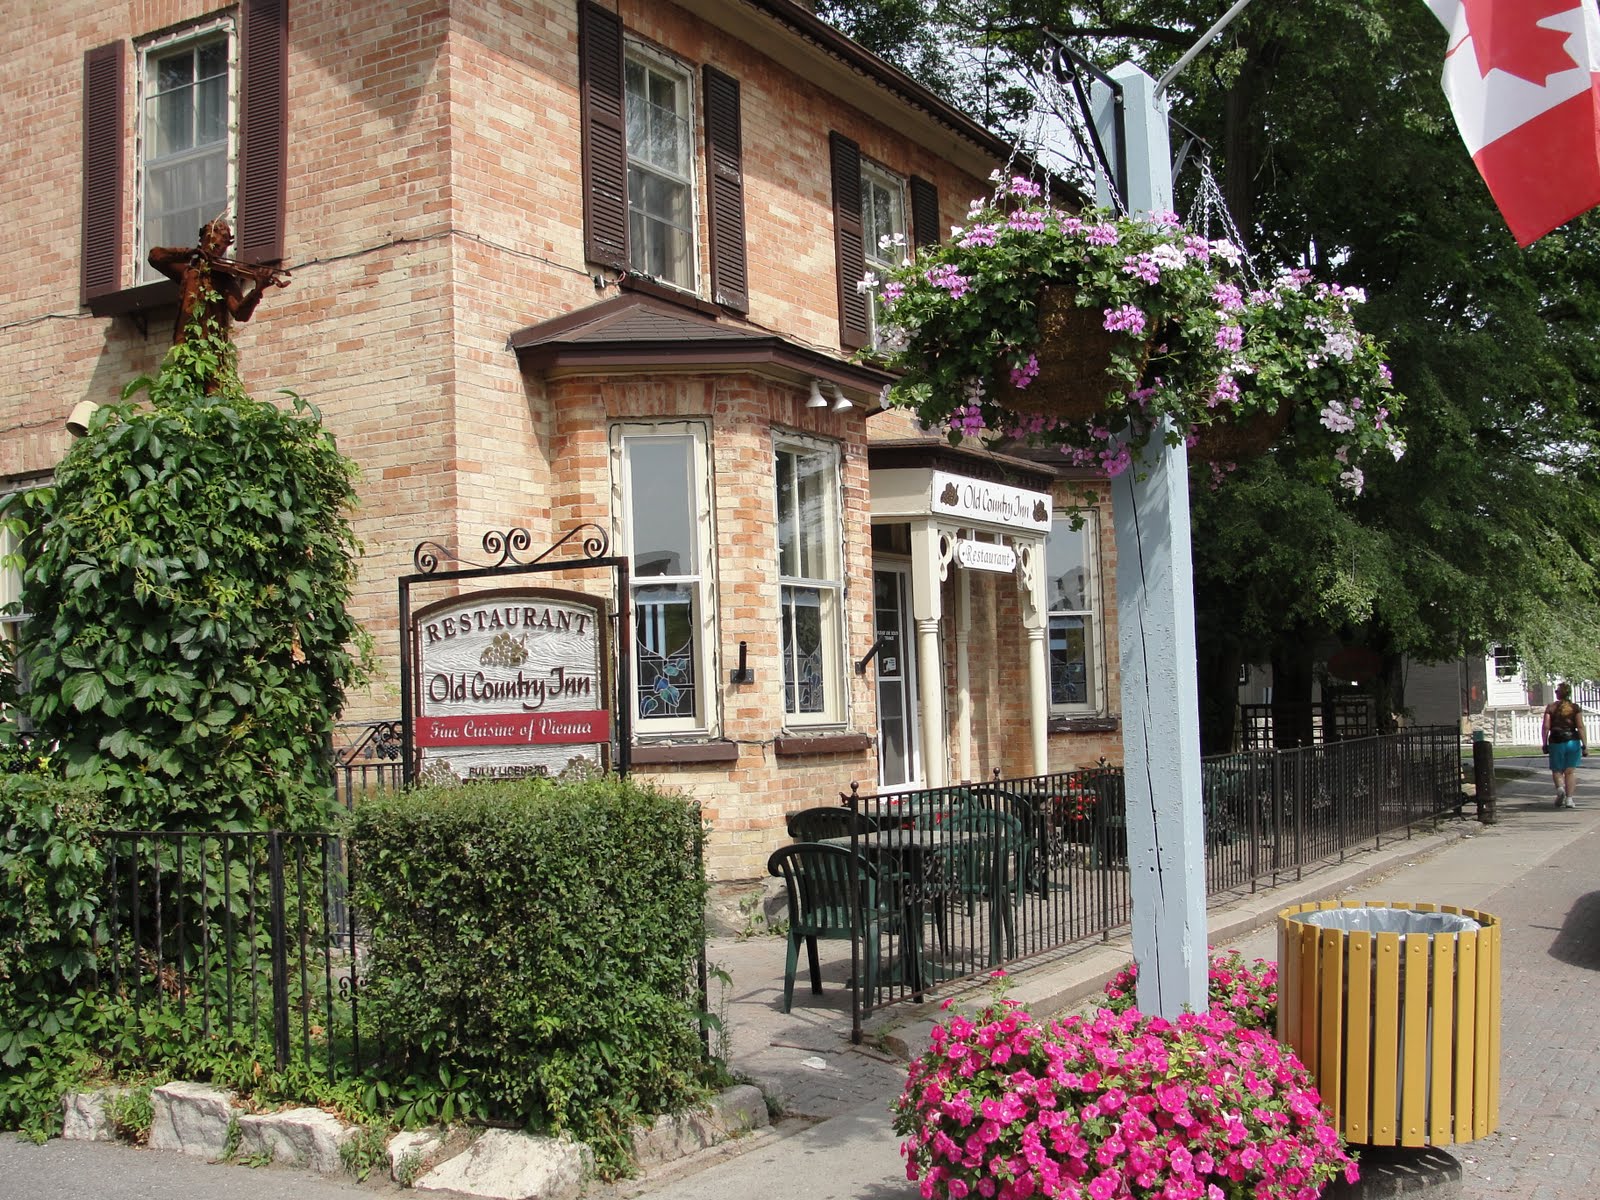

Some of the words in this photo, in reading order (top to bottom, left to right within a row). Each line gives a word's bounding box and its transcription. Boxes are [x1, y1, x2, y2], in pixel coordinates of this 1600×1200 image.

[963, 484, 982, 510] Old
[982, 488, 1014, 521] Country
[1014, 495, 1030, 519] Inn
[966, 545, 1010, 566] Restaurant
[425, 607, 592, 643] RESTAURANT
[429, 671, 467, 702] Old
[471, 671, 546, 710] Country
[549, 667, 591, 698] Inn
[430, 721, 460, 739] Fine
[464, 719, 515, 737] Cuisine
[520, 719, 535, 741] of
[539, 717, 592, 735] Vienna
